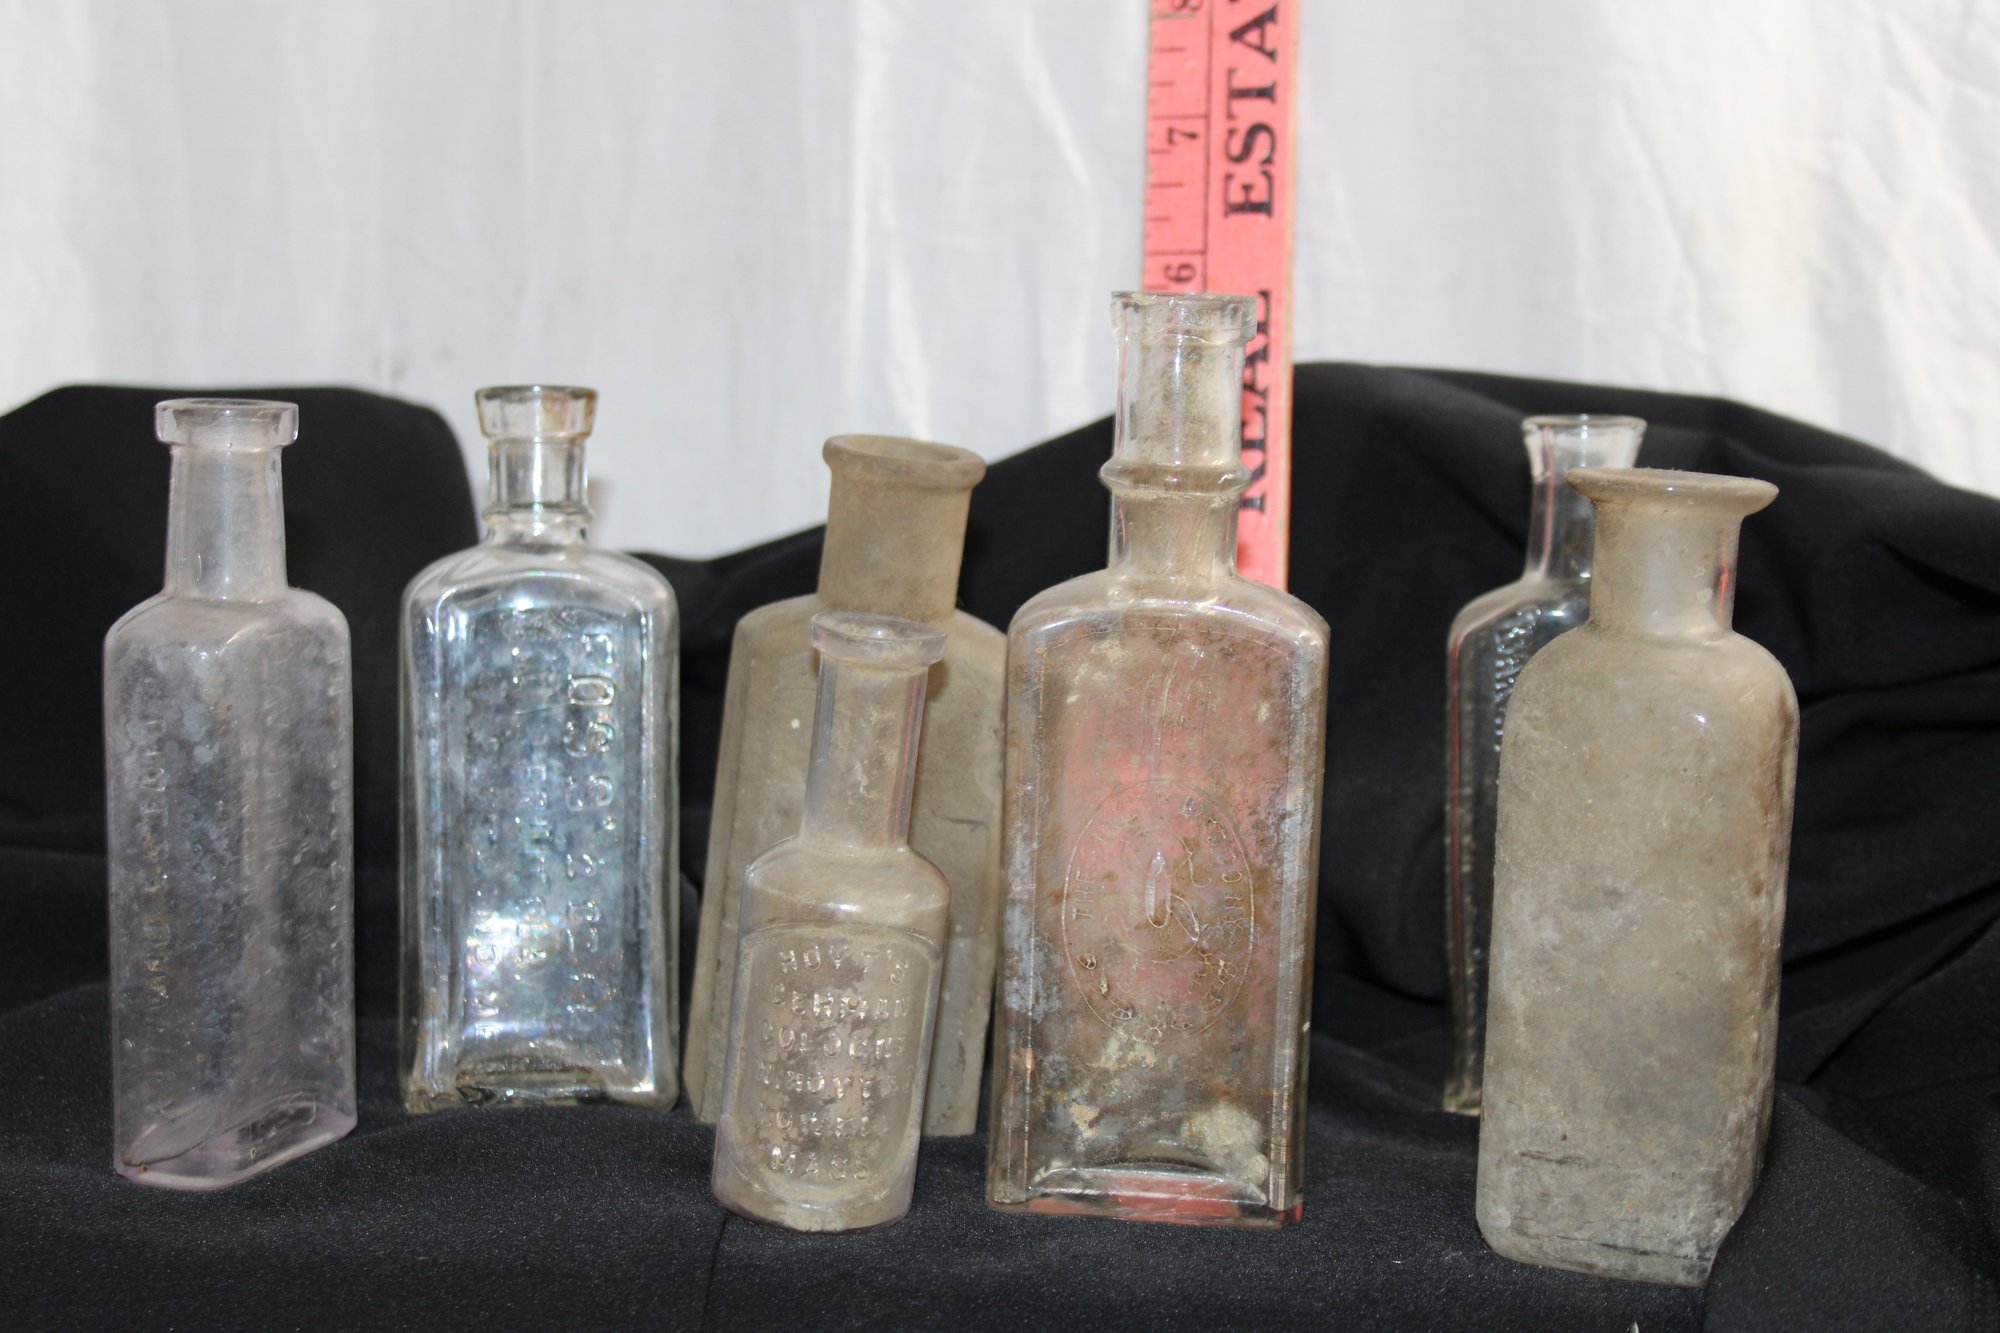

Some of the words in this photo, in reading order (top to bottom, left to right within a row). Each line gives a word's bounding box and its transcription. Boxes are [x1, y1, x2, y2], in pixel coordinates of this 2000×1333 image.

[1224, 0, 1279, 218] ESTA
[1167, 126, 1200, 146] 7
[1163, 262, 1197, 284] 6
[771, 982, 911, 1020] GERMAN
